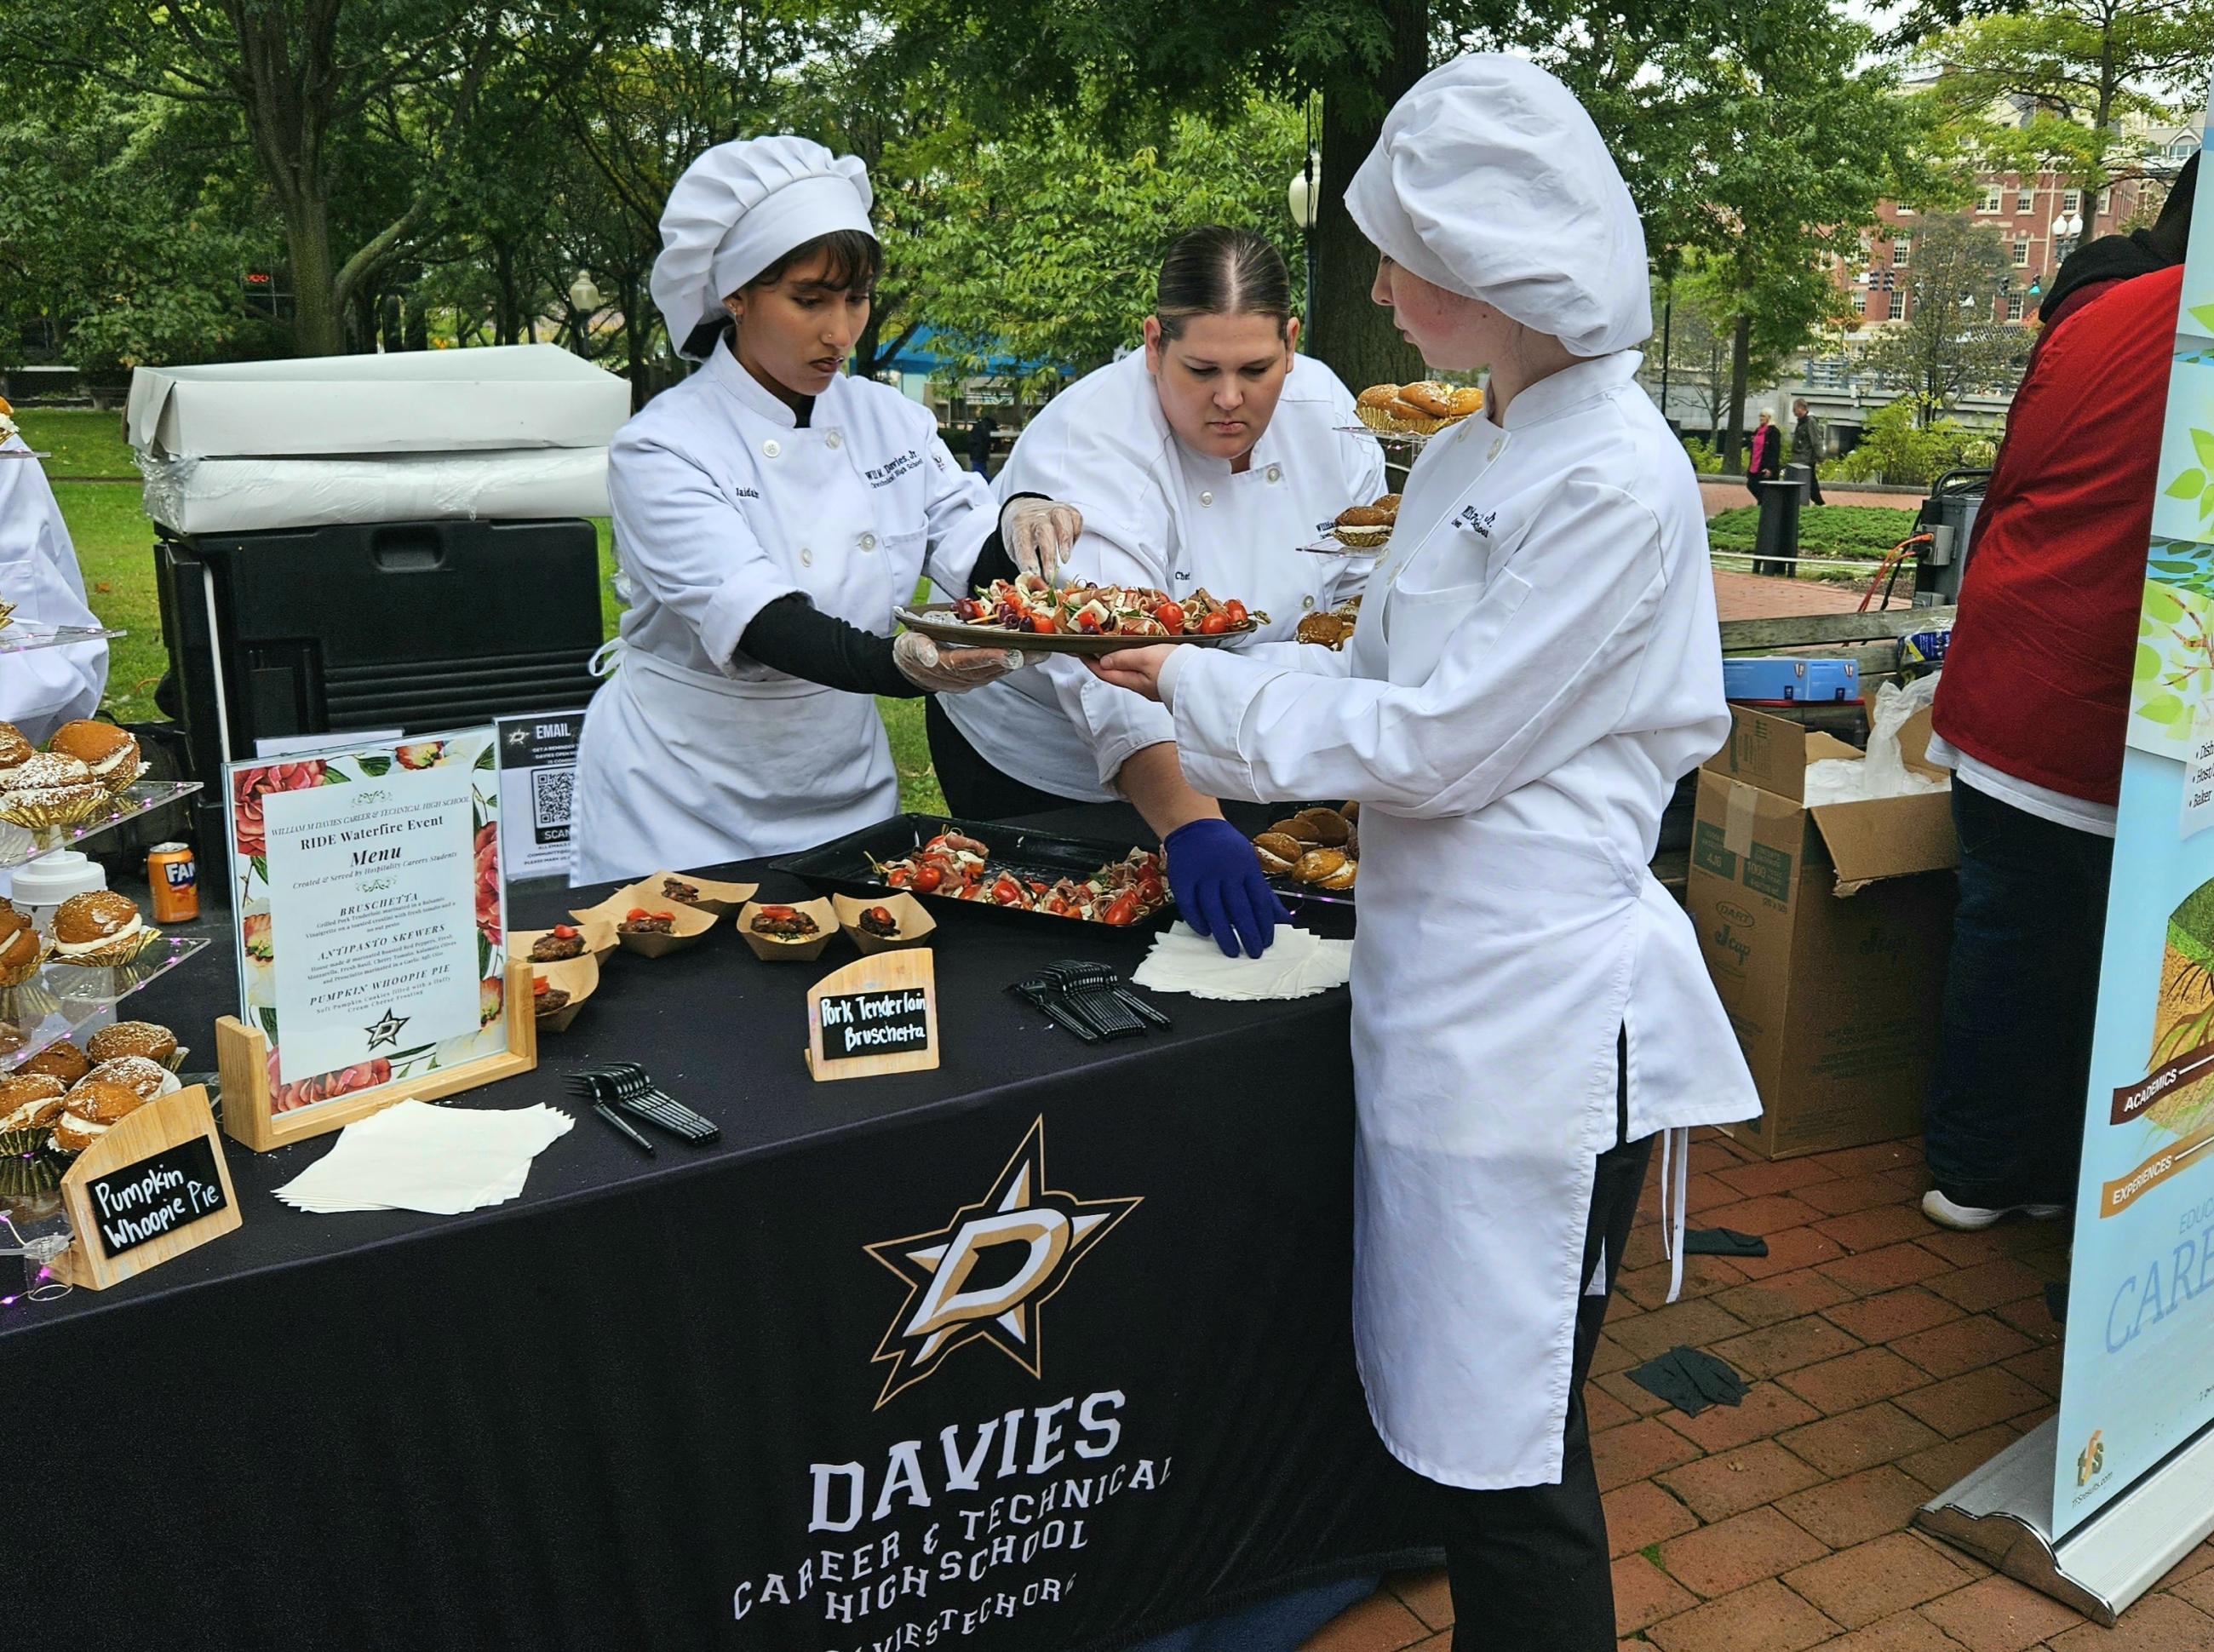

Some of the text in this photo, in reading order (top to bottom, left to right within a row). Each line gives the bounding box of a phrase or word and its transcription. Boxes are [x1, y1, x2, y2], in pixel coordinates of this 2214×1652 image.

[536, 723, 571, 739] EMAIL
[315, 818, 341, 829] DAVIES
[343, 812, 370, 823] CAREER
[380, 804, 422, 817] TECHNICAL
[422, 801, 441, 810] HIGH
[443, 796, 470, 806] SCHOOL
[301, 816, 443, 850] RIDE Waterfire Event
[293, 878, 319, 889] Created
[331, 871, 353, 880] Served
[364, 863, 400, 875] Hospitality
[430, 852, 456, 862] Students
[351, 847, 401, 866] Menu
[340, 893, 417, 916] BRUSCHETTA
[318, 925, 445, 961] ANTIPASTO SKEWERS
[310, 964, 450, 1006] PUMPKIN WHOOPIE PIE
[821, 992, 926, 1027] Pork Tenderloin
[2124, 1068, 2178, 1112] ACADEMICS
[95, 1163, 184, 1219] Pumpkin
[2113, 1155, 2172, 1205] EXPERIENCES
[103, 1180, 220, 1249] Whoopie Pie
[808, 1390, 1126, 1532] DAVIES
[734, 1530, 900, 1620] CAREER
[959, 1456, 1173, 1541] TECHNICAL
[824, 1519, 1088, 1623] HIGH SCHOOL
